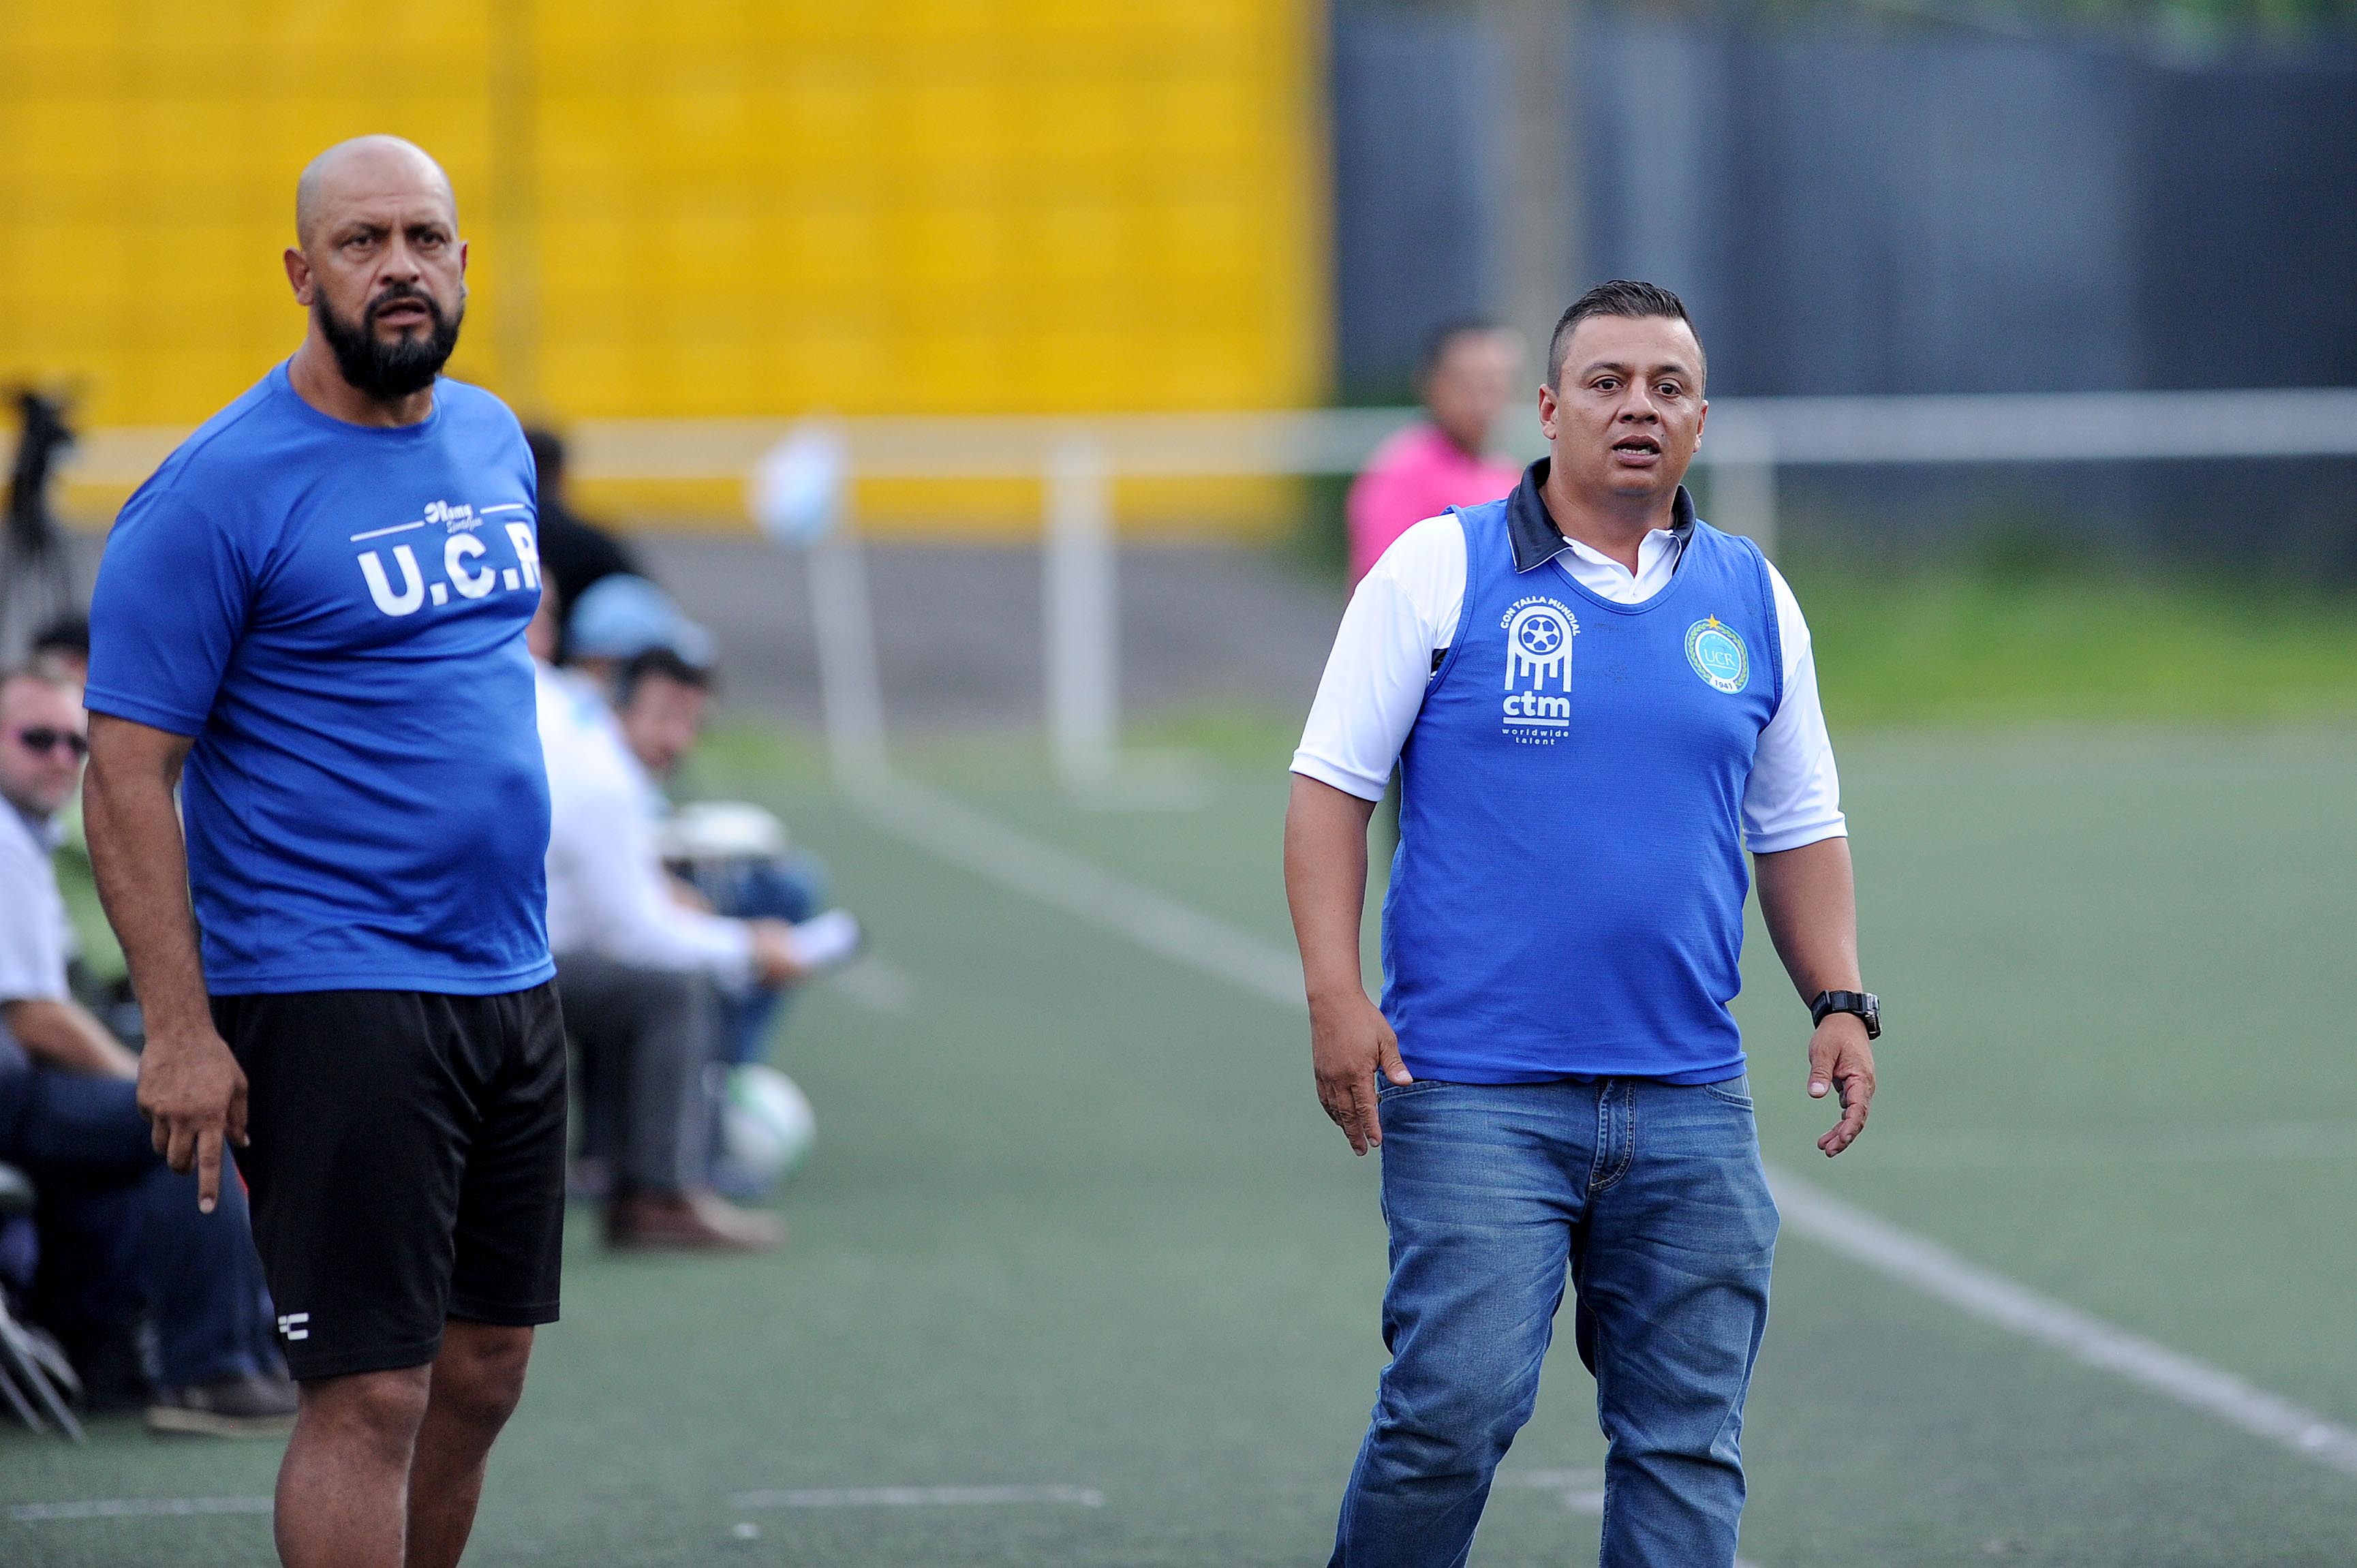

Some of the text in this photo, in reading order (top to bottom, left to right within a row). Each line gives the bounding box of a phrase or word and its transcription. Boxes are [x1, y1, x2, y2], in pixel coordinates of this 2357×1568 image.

[1500, 596, 1581, 636] CON TALLA MUNDIAL
[1704, 648, 1736, 666] UCR
[1714, 679, 1733, 690] 1941
[1503, 690, 1570, 718] ctm
[1502, 728, 1569, 737] worldwide
[1515, 737, 1556, 745] talent
